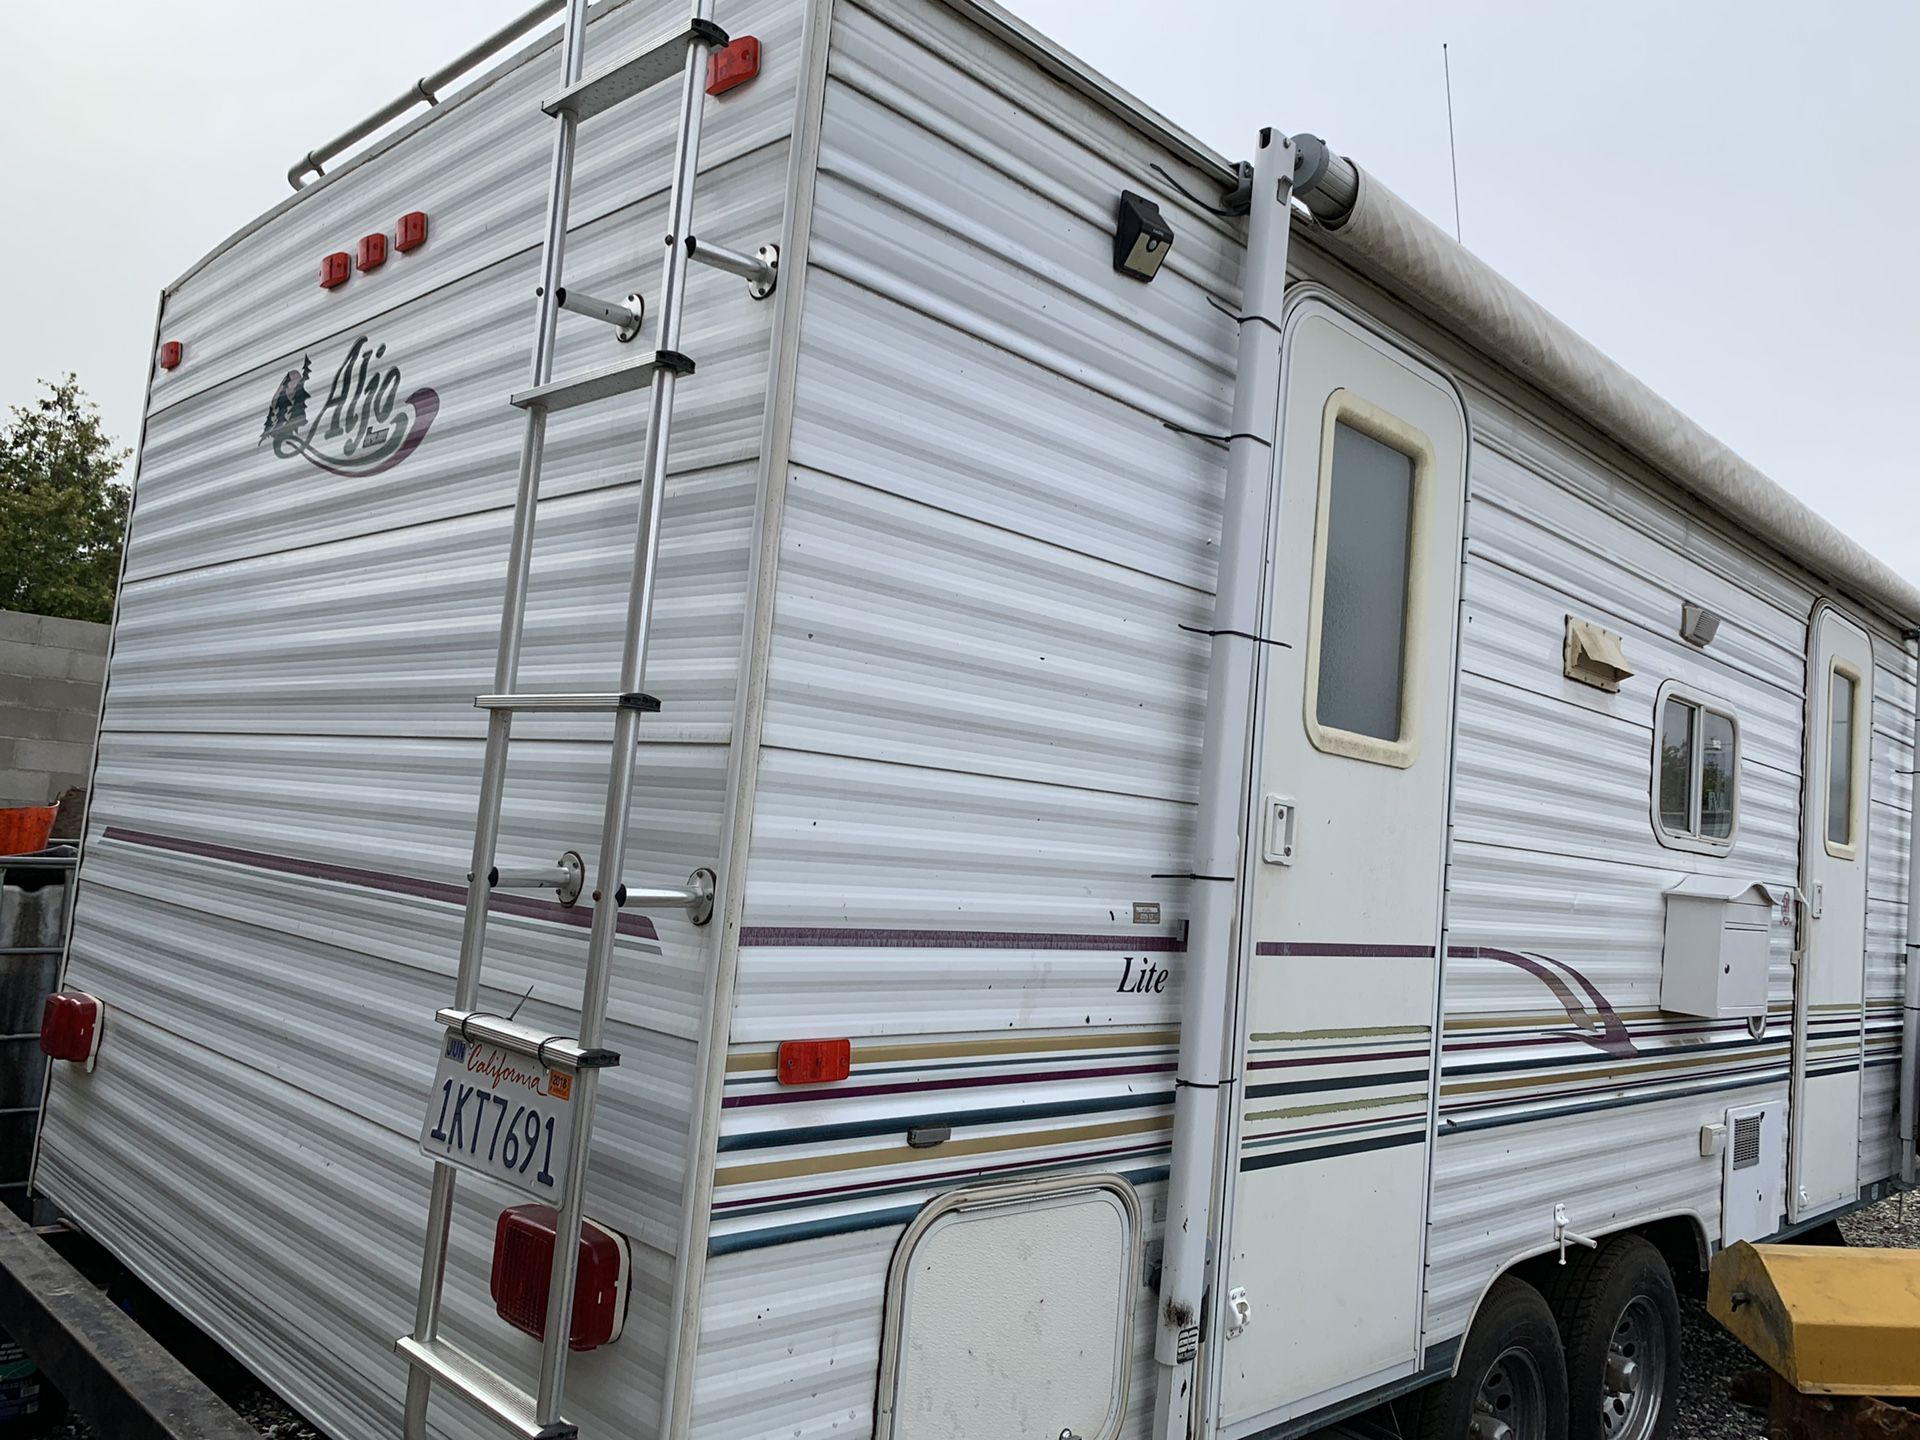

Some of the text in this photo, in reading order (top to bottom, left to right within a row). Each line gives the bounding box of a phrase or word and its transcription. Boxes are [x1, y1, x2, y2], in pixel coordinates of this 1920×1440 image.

[306, 335, 401, 456] Aljo
[1116, 957, 1169, 994] Lite
[446, 1039, 467, 1060] JUN
[467, 1043, 548, 1096] California
[430, 1079, 555, 1187] 1KT7691
